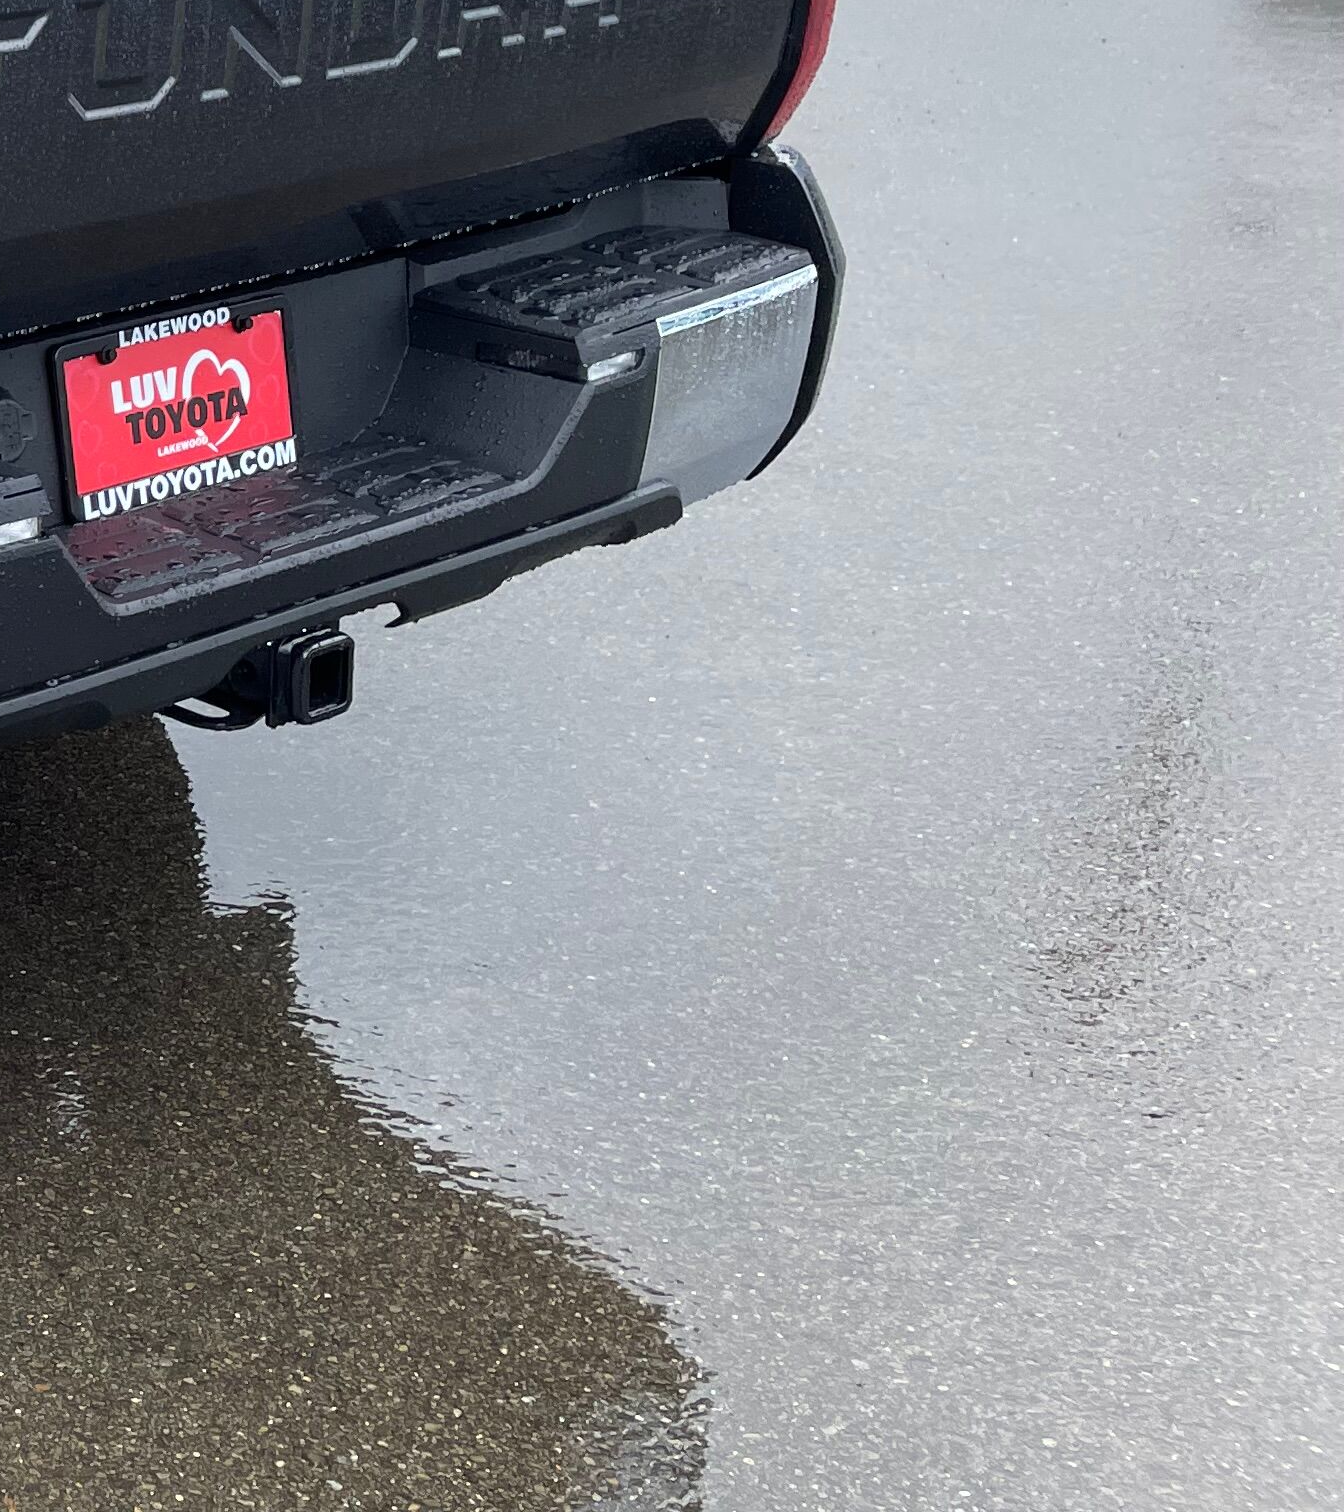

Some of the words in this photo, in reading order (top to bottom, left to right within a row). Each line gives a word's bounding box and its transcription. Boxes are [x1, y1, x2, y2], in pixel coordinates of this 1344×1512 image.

[118, 306, 231, 348] LAKEWOOD
[110, 366, 177, 414] LUV
[125, 387, 248, 444] TOYOTA
[157, 435, 209, 457] LAKEWOOD
[82, 438, 297, 521] LUVTOYOTA.COM
